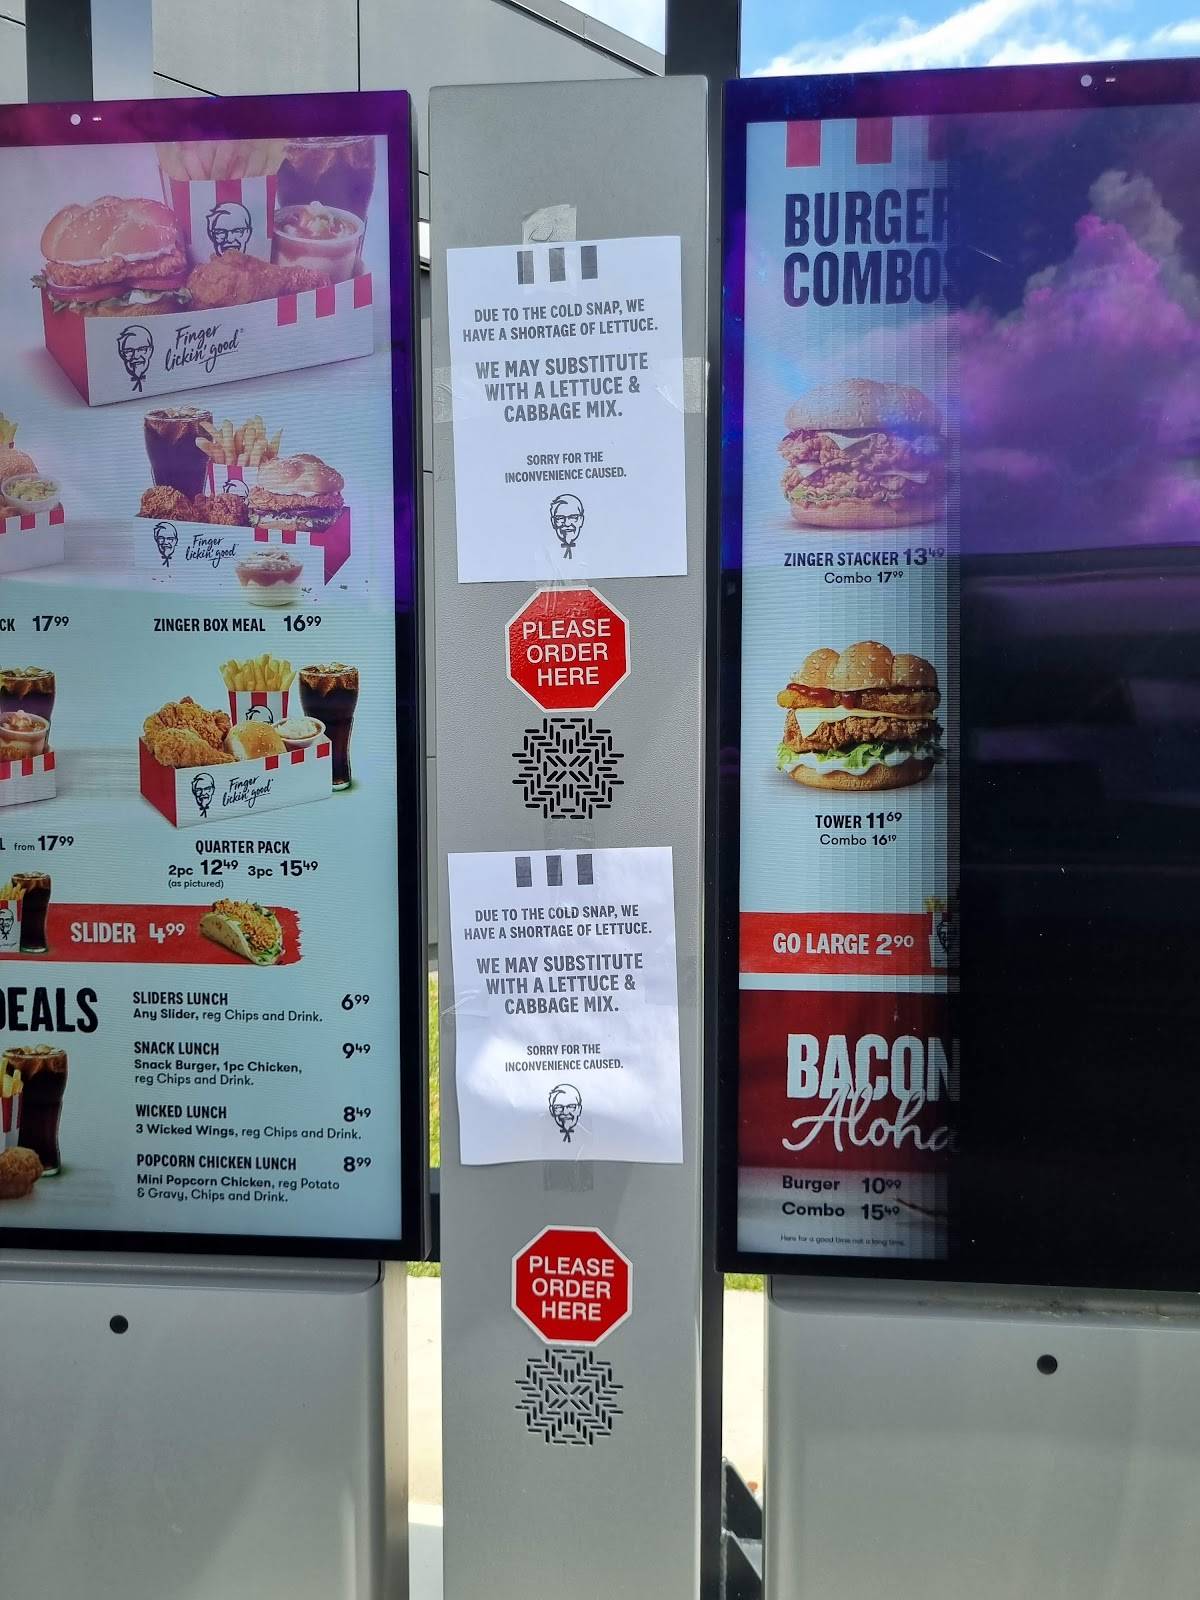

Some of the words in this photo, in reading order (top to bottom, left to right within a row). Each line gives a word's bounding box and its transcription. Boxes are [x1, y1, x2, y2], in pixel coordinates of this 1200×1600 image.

[785, 187, 957, 247] BURGER
[474, 308, 499, 323] DUE
[502, 307, 519, 321] TO
[522, 306, 547, 320] THE
[550, 303, 582, 318] COLD
[586, 301, 623, 316] SNAP,
[626, 298, 645, 313] WE
[175, 324, 222, 349] Finger
[463, 328, 495, 342] HAVE
[499, 327, 507, 341] A
[510, 323, 576, 340] SHORTAGE
[580, 322, 596, 336] OF
[599, 317, 659, 335] LETTUCE.
[475, 361, 500, 379] WE
[505, 359, 540, 377] MAY
[545, 352, 649, 376] SUBSTITUTE
[485, 383, 528, 401] WITH
[534, 381, 546, 399] A
[550, 376, 623, 398] LETTUCE
[628, 375, 641, 393] &
[504, 402, 581, 423] CABBAGE
[586, 400, 623, 418] MIX.
[526, 454, 560, 466] SORRY
[562, 452, 582, 464] FOR
[584, 451, 604, 463] THE
[505, 469, 583, 484] INCONVENIENCE
[585, 467, 627, 480] CAUSED.
[192, 533, 224, 551] Finger
[783, 552, 833, 567] ZINGER
[837, 551, 899, 566] STACKER
[824, 571, 872, 584] Combo
[153, 617, 200, 632] ZINGER
[203, 618, 229, 632] BOX
[232, 618, 266, 632] MEAL
[522, 618, 612, 640] PLEASE
[526, 642, 609, 663] ORDER
[537, 666, 600, 687] HERE
[229, 775, 260, 793] Finger
[815, 814, 862, 829] TOWER
[14, 842, 35, 851] from
[195, 840, 255, 855] QUARTER
[258, 840, 290, 854] PACK
[819, 834, 867, 846] Combo
[168, 864, 194, 879] 2pc
[247, 865, 273, 879] 3pc
[168, 880, 182, 889] (as
[183, 879, 224, 889] pictured)
[475, 909, 499, 923] DUE
[502, 908, 518, 921] TO
[521, 907, 545, 921] THE
[548, 906, 580, 920] COLD
[582, 905, 618, 919] SNAP,
[621, 904, 639, 917] WE
[70, 922, 136, 944] SLIDER
[464, 927, 495, 940] HAVE
[499, 927, 507, 939] A
[510, 924, 574, 939] SHORTAGE
[576, 923, 592, 936] OF
[595, 921, 653, 936] LETTUCE.
[773, 932, 801, 953] GO
[806, 933, 870, 955] LARGE
[476, 957, 500, 974] WE
[505, 956, 539, 973] MAY
[543, 952, 643, 973] SUBSTITUTE
[486, 977, 528, 995] WITH
[533, 977, 545, 994] A
[549, 974, 619, 993] LETTUCE
[624, 973, 636, 991] &
[133, 991, 184, 1005] SLIDERS
[187, 992, 228, 1006] LUNCH
[504, 996, 579, 1015] CABBAGE
[584, 995, 619, 1013] MIX.
[0, 987, 98, 1033] EALS
[133, 1008, 157, 1020] Any
[160, 1008, 199, 1021] Slider,
[202, 1012, 221, 1022] reg
[225, 1009, 259, 1023] Chips
[262, 1010, 285, 1022] and
[288, 1010, 323, 1022] Drink.
[134, 1041, 175, 1055] SNACK
[178, 1042, 219, 1056] LUNCH
[527, 1045, 559, 1056] SORRY
[561, 1044, 580, 1055] FOR
[582, 1043, 601, 1054] THE
[134, 1059, 172, 1070] Snack
[175, 1060, 220, 1073] Burger,
[223, 1061, 245, 1073] 1pc
[247, 1061, 302, 1074] Chicken,
[505, 1060, 581, 1073] INCONVENIENCE
[583, 1058, 624, 1071] CAUSED.
[786, 1033, 960, 1101] BACON
[135, 1075, 154, 1086] reg
[157, 1073, 191, 1086] Chips
[194, 1074, 217, 1085] and
[220, 1074, 254, 1086] Drink.
[136, 1104, 183, 1118] WICKED
[186, 1105, 227, 1119] LUNCH
[136, 1123, 143, 1134] 3
[147, 1123, 192, 1135] Wicked
[196, 1124, 238, 1138] Wings,
[241, 1128, 260, 1139] reg
[264, 1126, 298, 1140] Chips
[301, 1127, 324, 1139] and
[327, 1127, 362, 1140] Drink.
[136, 1153, 195, 1168] POPCORN
[198, 1155, 252, 1169] CHICKEN
[255, 1156, 296, 1170] LUNCH
[137, 1173, 163, 1185] Mini
[166, 1174, 218, 1188] Popcorn
[221, 1175, 275, 1189] Chicken,
[278, 1179, 297, 1190] reg
[301, 1178, 340, 1190] Potato
[782, 1175, 841, 1193] Burger
[148, 1188, 188, 1202] Gravy,
[191, 1189, 225, 1203] Chips
[228, 1190, 250, 1201] and
[254, 1190, 288, 1202] Drink.
[782, 1201, 845, 1217] Combo
[529, 1255, 615, 1277] PLEASE
[532, 1278, 612, 1299] ORDER
[541, 1300, 602, 1321] HERE
